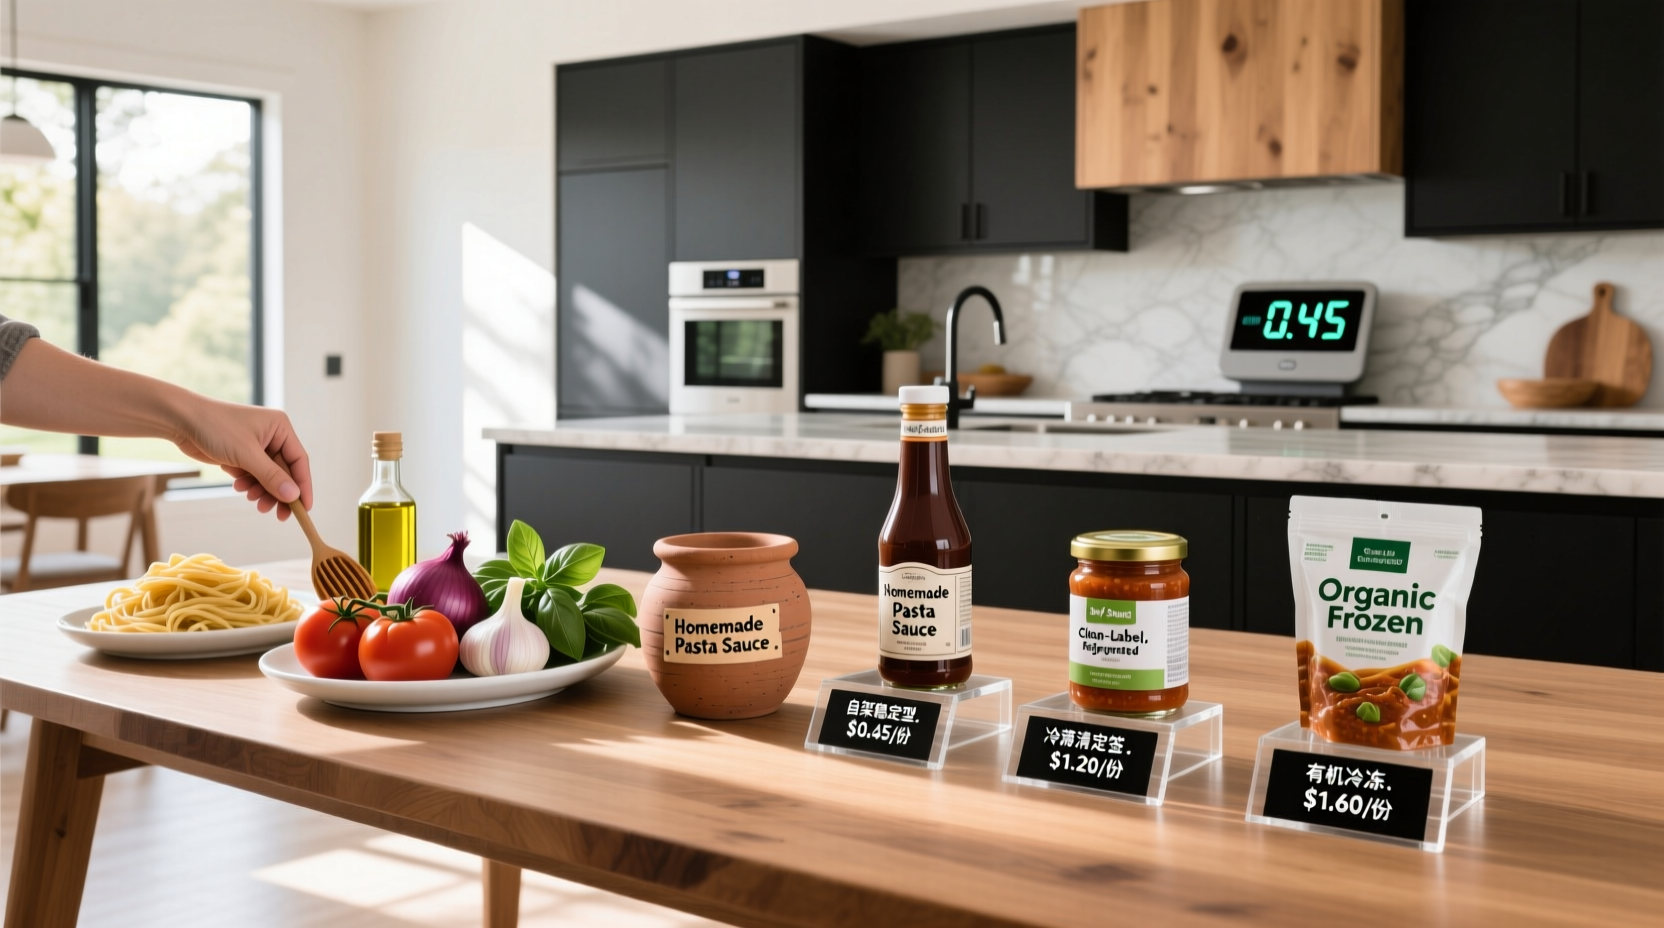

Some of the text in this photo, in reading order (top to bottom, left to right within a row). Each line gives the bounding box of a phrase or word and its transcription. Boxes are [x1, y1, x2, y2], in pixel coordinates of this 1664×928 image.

[1262, 300, 1350, 341] 0.45
[1318, 577, 1436, 612] Organic
[892, 601, 936, 619] Pasta
[1327, 605, 1424, 635] Frozen
[674, 614, 764, 635] Homemade
[891, 619, 937, 637] Sauce
[675, 636, 770, 655] Pasta Sauce
[846, 718, 911, 745] $0.45/份
[1049, 750, 1124, 779] $1.20/份
[1303, 786, 1393, 821] $1.60/份
